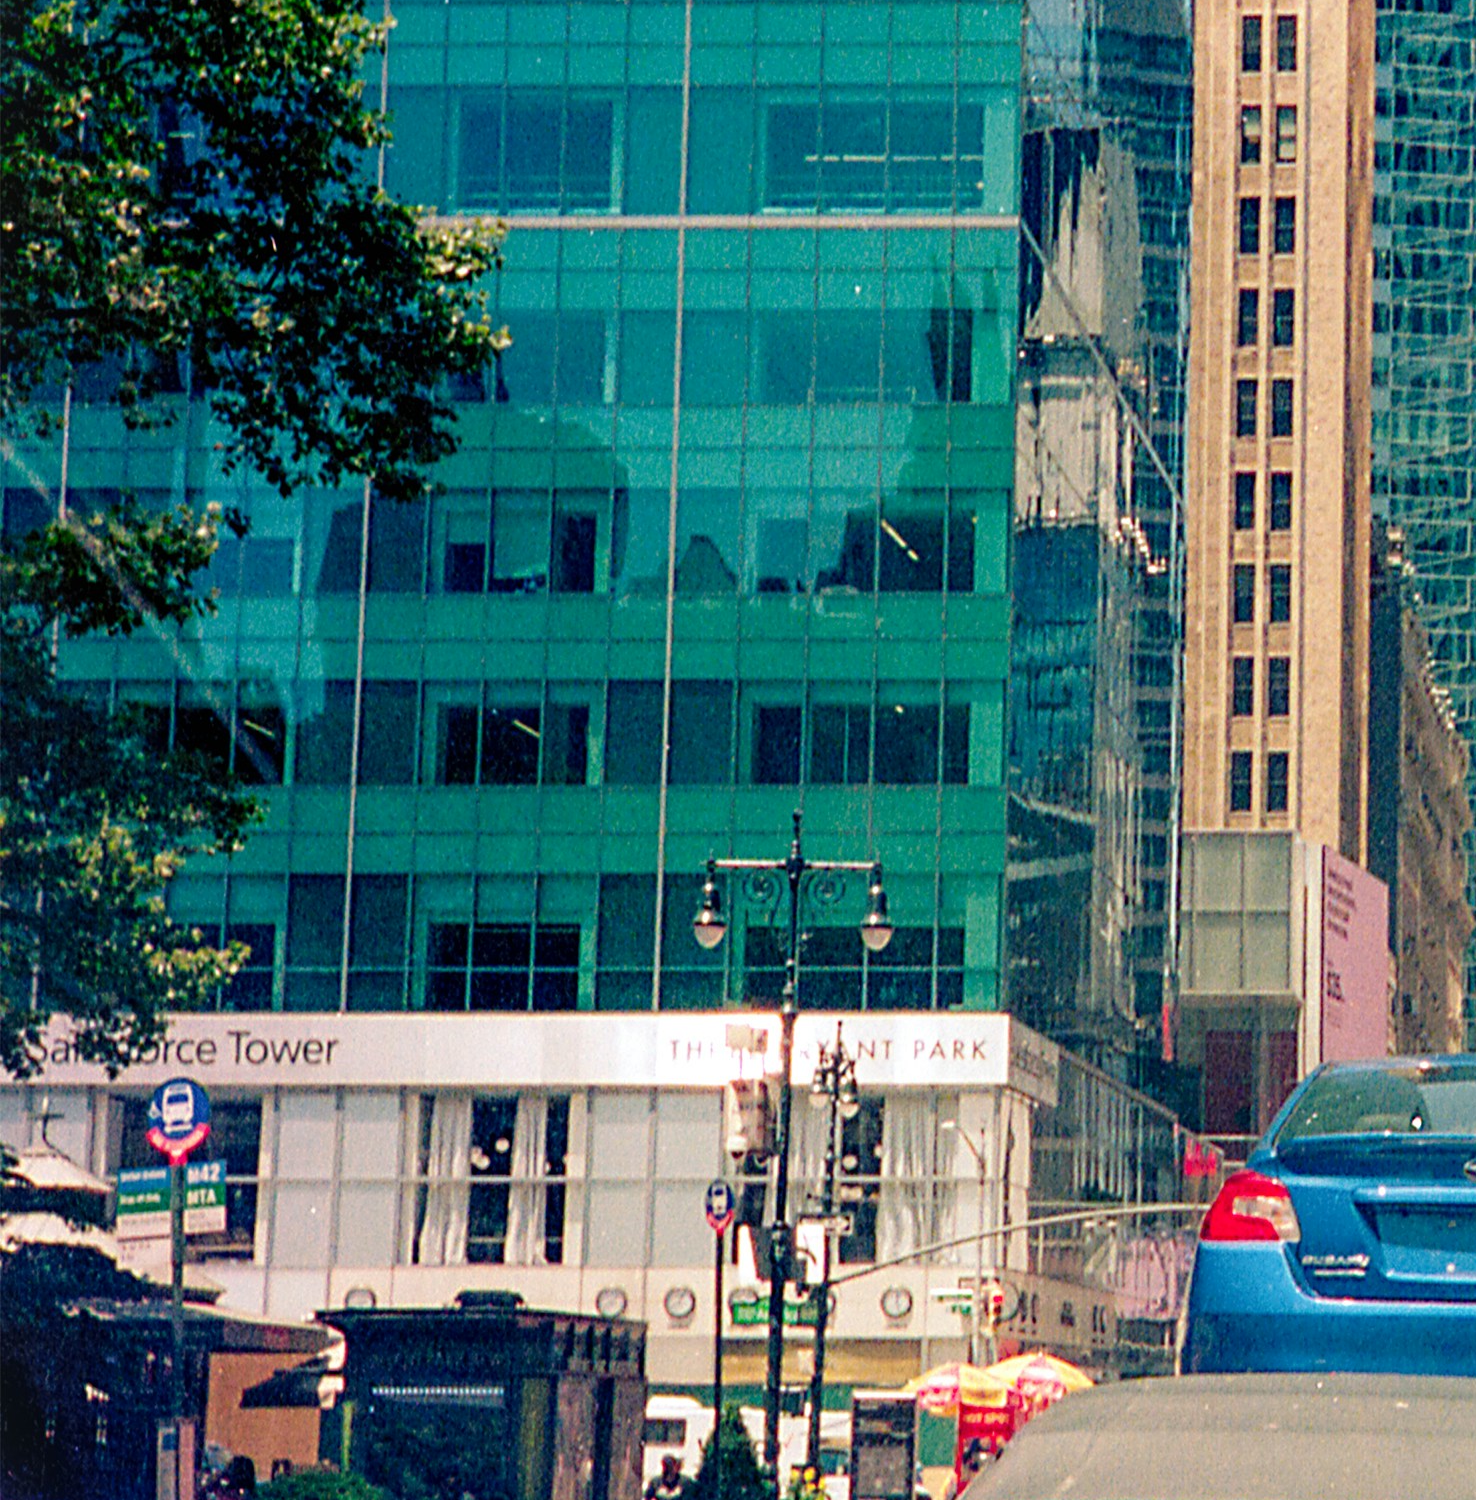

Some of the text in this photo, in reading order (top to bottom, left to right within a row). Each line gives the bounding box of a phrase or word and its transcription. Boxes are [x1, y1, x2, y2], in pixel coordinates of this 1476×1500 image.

[24, 1028, 338, 1065] Saorce Tower
[913, 1039, 988, 1061] PARK
